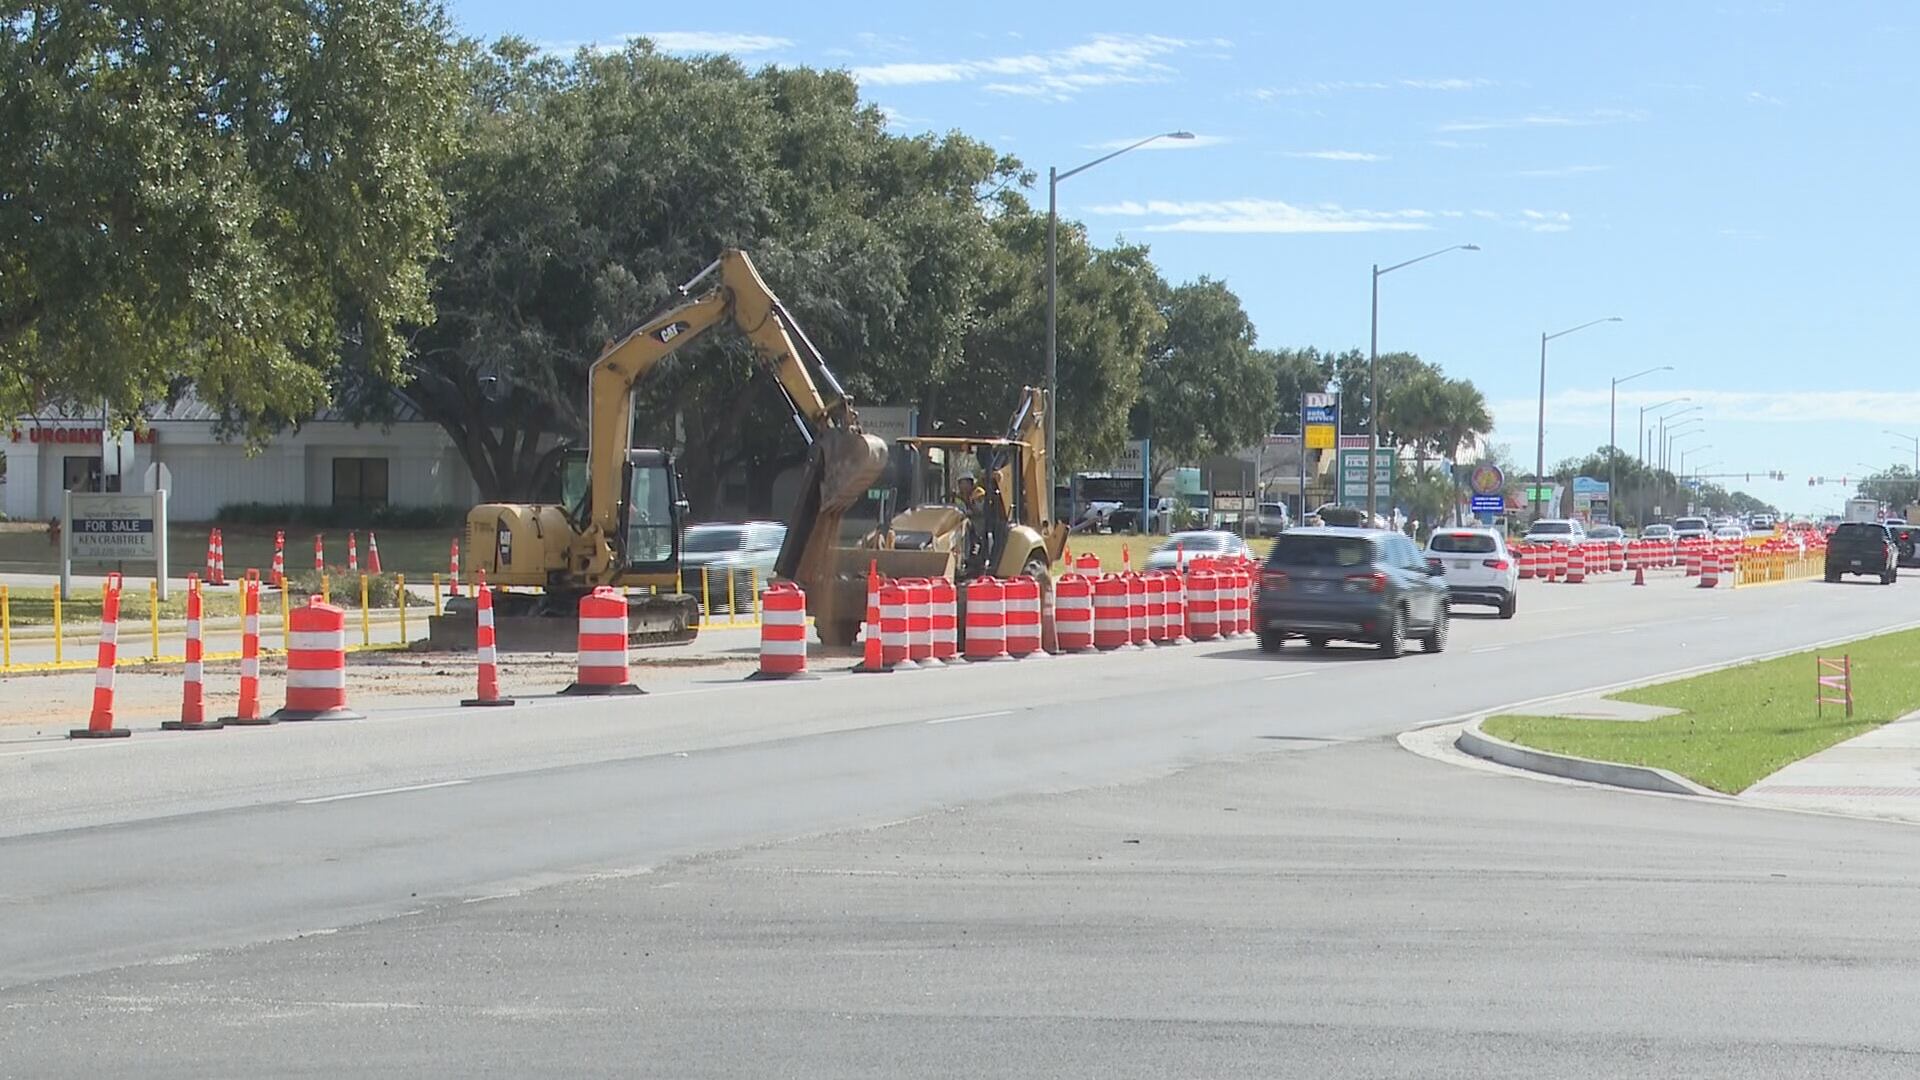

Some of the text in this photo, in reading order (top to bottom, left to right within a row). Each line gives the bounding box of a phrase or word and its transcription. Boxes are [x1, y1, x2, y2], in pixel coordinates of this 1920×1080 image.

[660, 323, 679, 342] CAT
[30, 428, 103, 443] URGENT
[85, 520, 140, 531] FOR SALE
[79, 535, 145, 545] KEN CRABTREE
